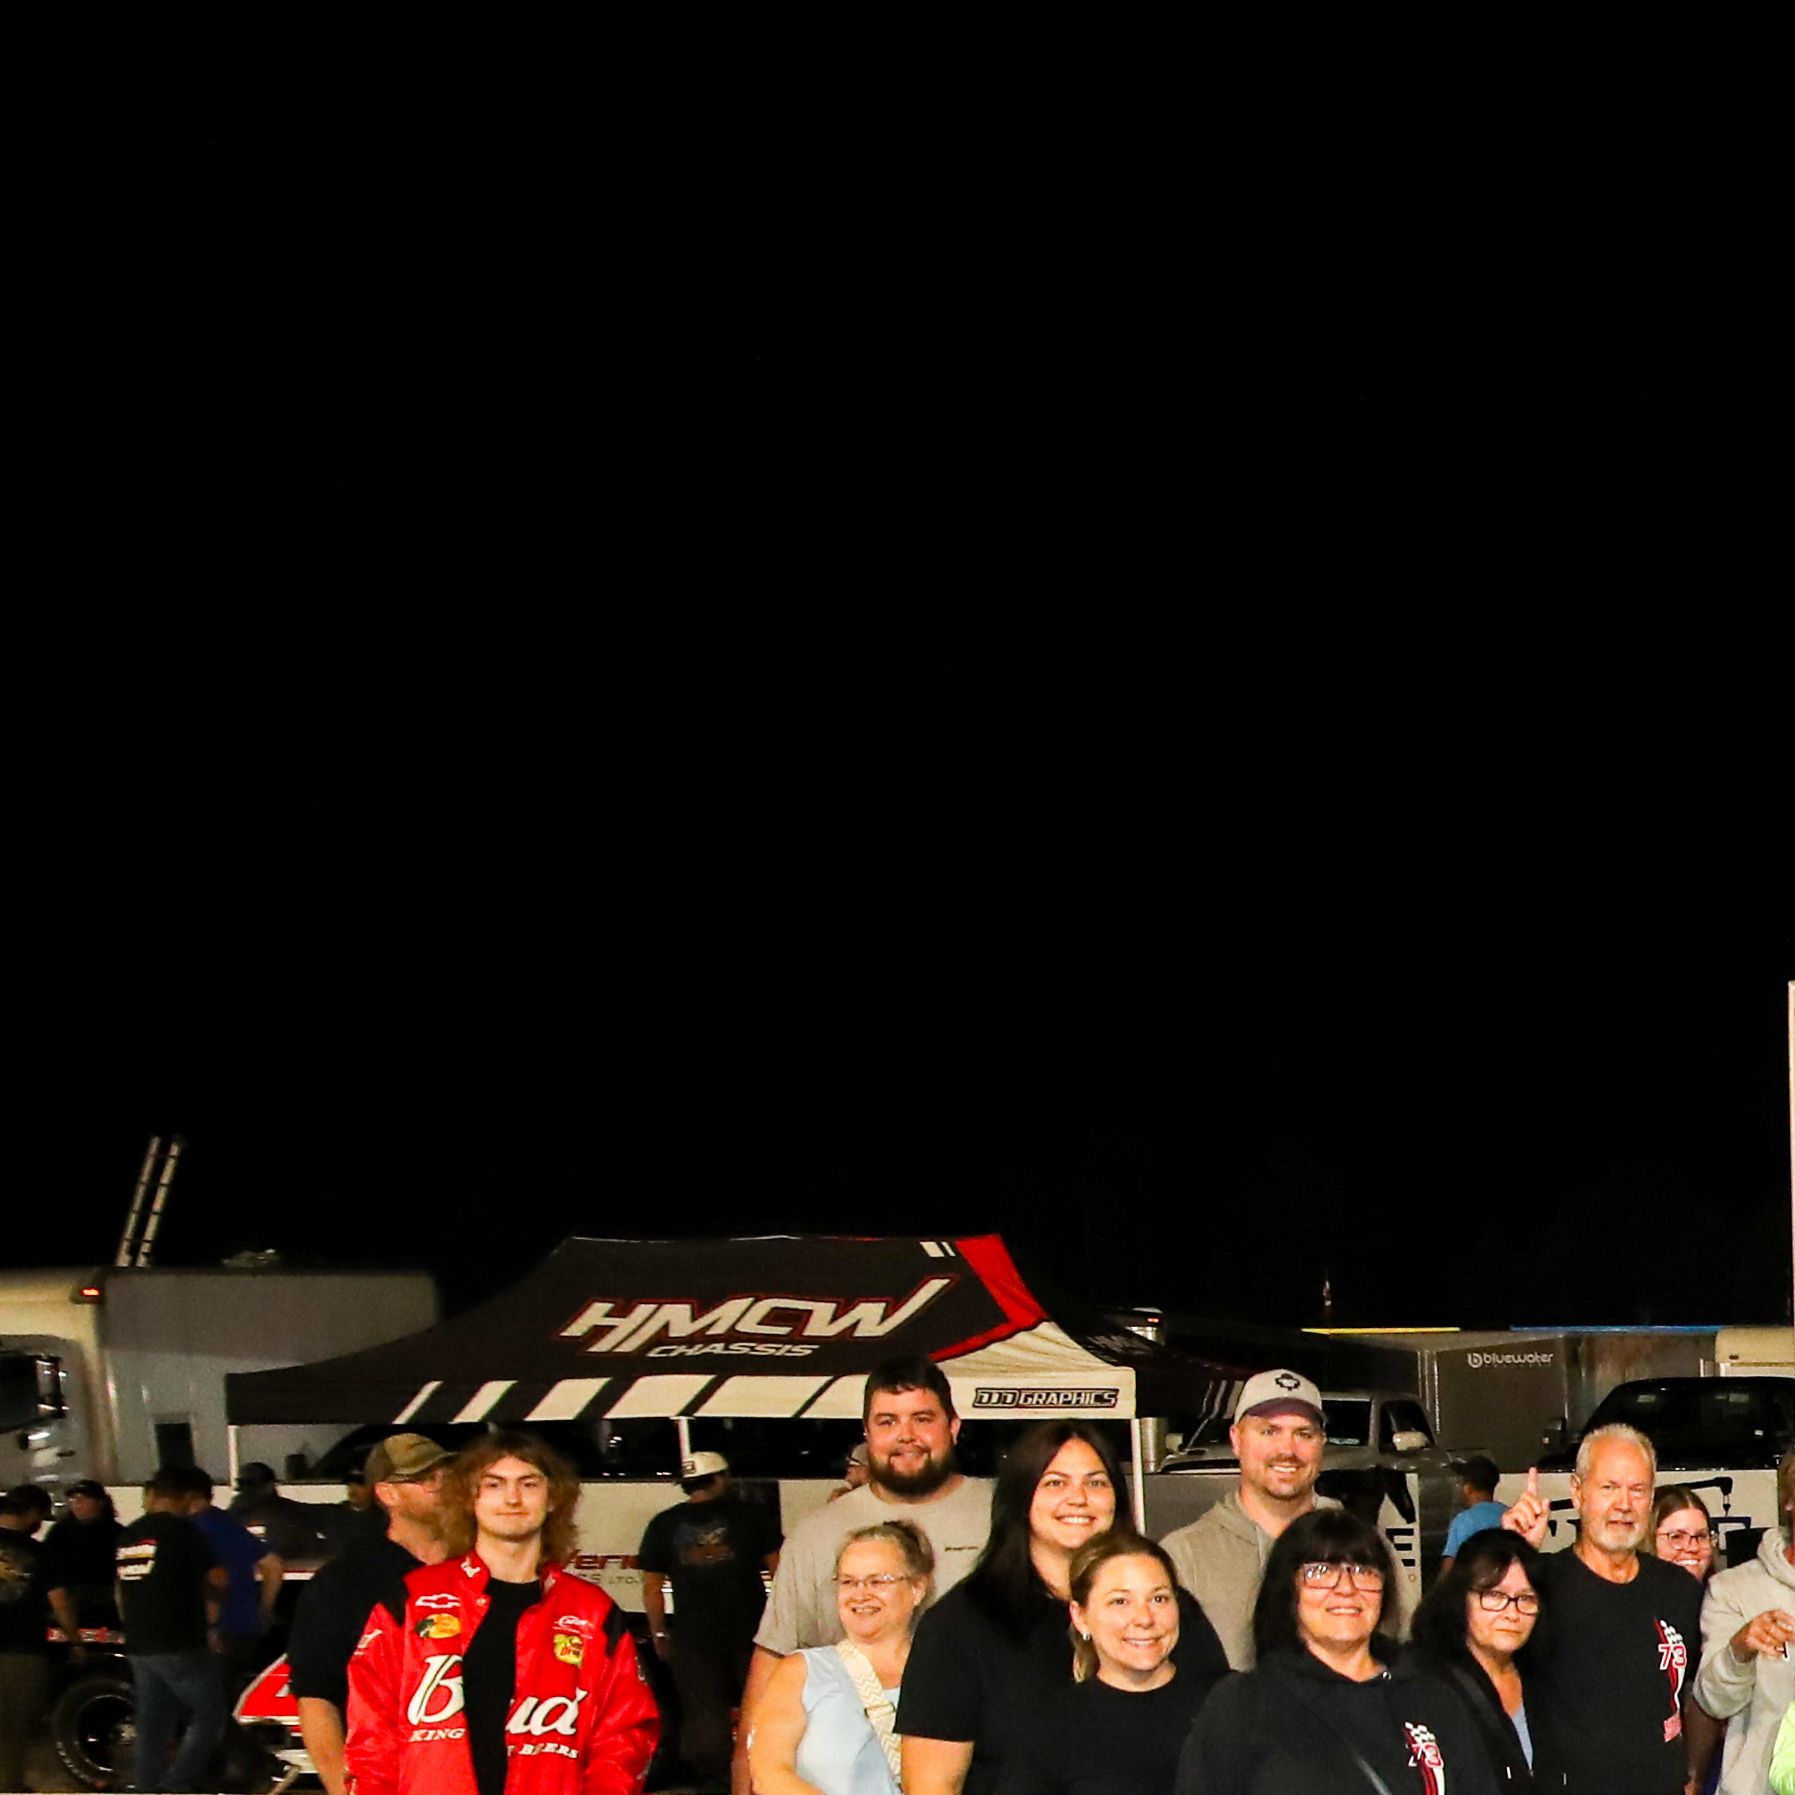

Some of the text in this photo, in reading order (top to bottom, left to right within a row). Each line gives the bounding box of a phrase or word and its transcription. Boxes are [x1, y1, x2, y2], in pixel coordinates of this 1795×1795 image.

[560, 1278, 952, 1353] HMCW
[646, 1342, 819, 1358] CHASSIS
[1483, 1352, 1554, 1364] bluewater
[1018, 1389, 1118, 1407] GRAPHICS
[1657, 1642, 1688, 1669] 73
[408, 1728, 466, 1742] KING
